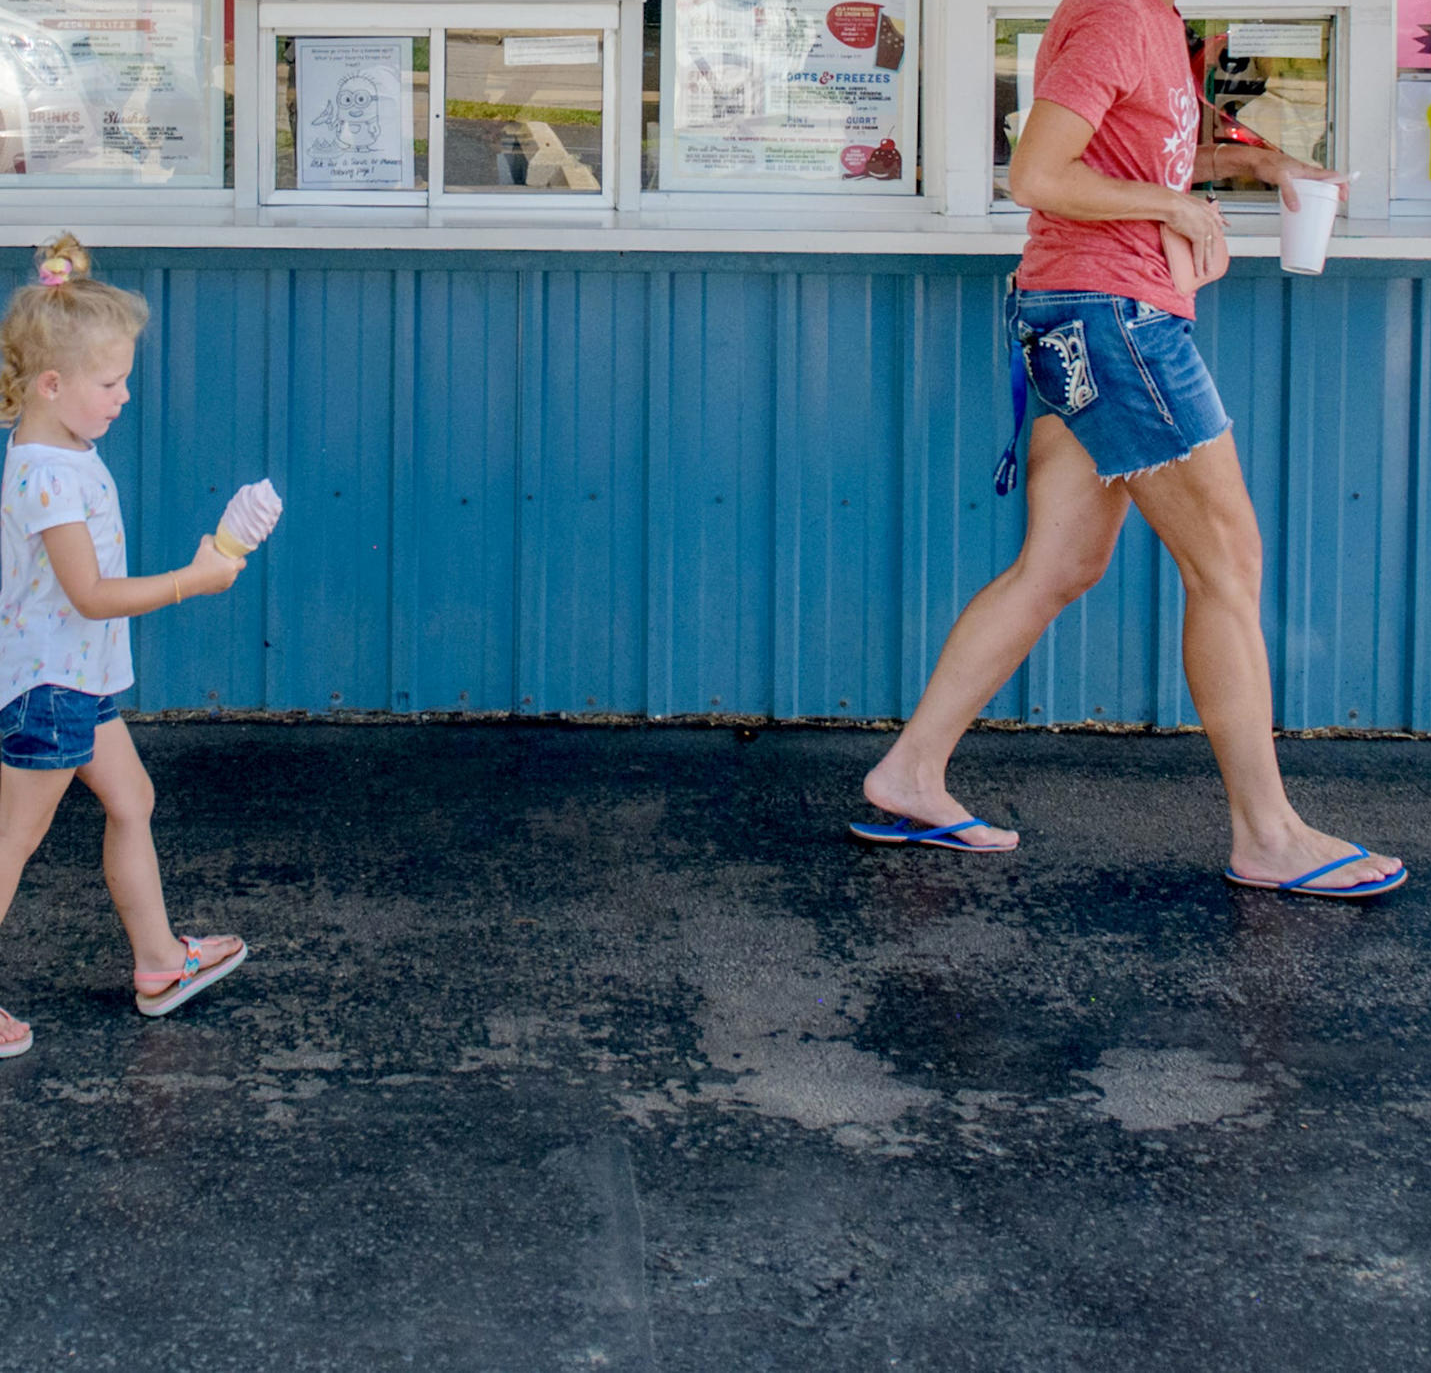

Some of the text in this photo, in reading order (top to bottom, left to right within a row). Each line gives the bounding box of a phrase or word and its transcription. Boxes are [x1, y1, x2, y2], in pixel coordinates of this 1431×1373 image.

[835, 73, 891, 84] FREEZES
[28, 111, 81, 123] DRINKS
[846, 116, 879, 125] QUART
